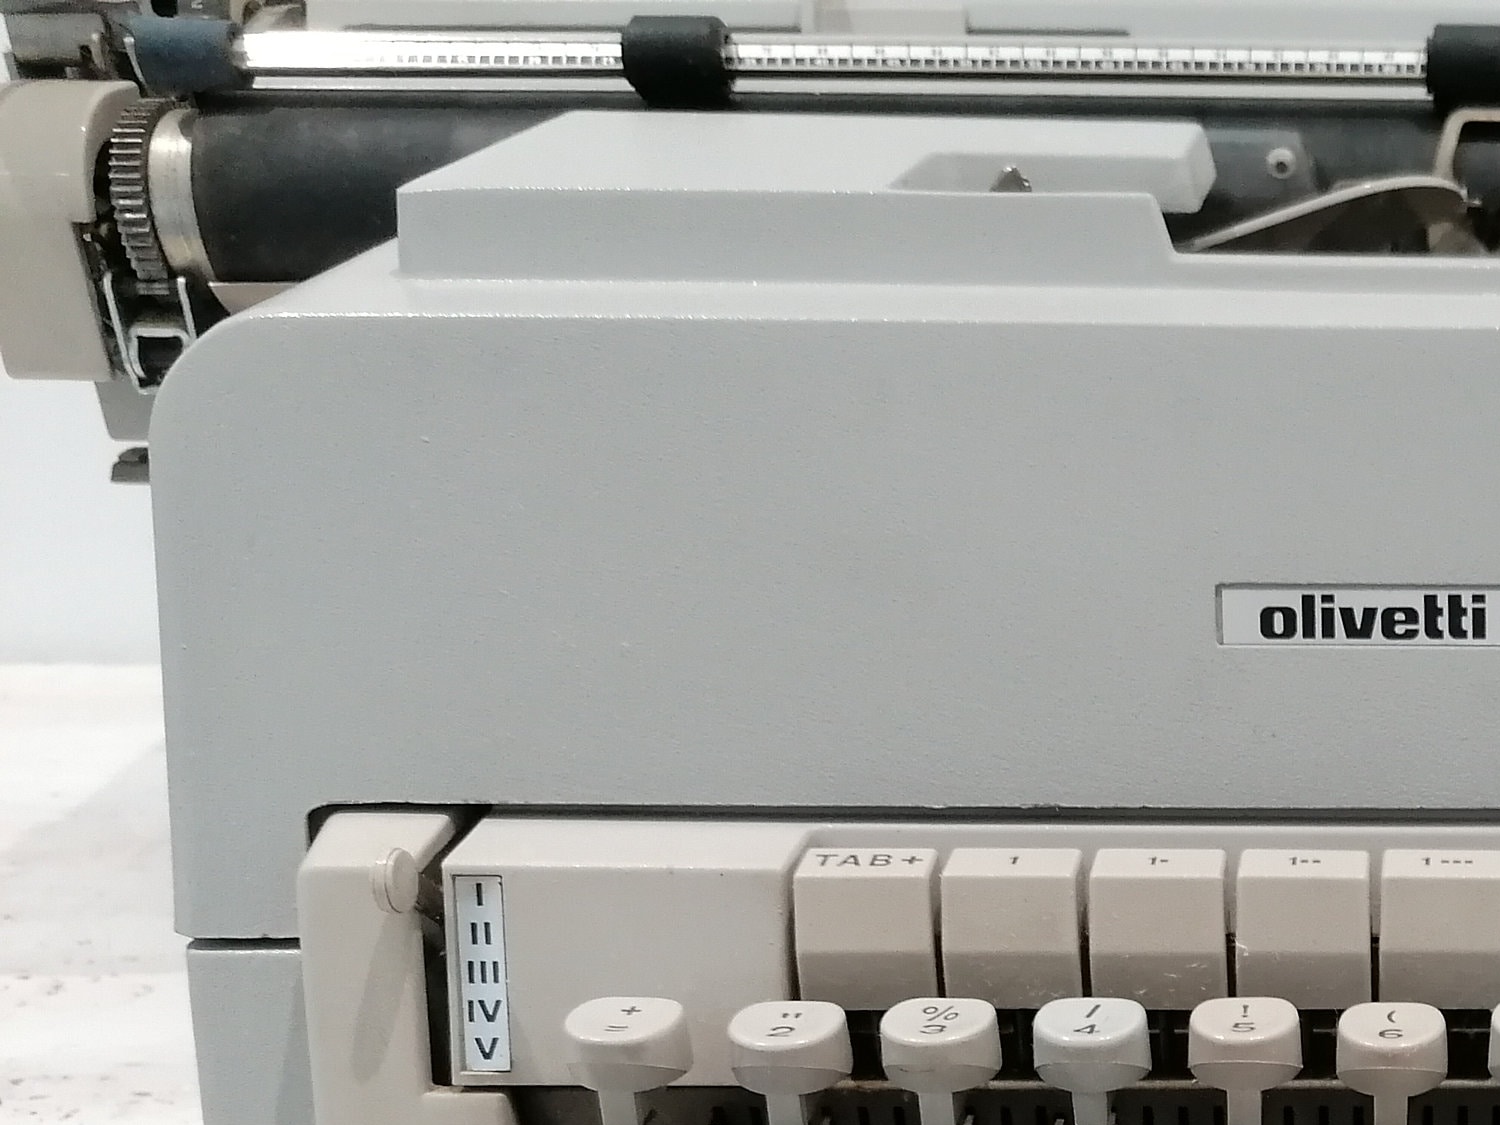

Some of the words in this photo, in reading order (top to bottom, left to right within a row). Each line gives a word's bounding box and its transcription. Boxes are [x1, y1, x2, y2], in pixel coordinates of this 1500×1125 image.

[1259, 593, 1487, 641] olivetti
[467, 999, 502, 1023] IV
[922, 1005, 960, 1022] %
[766, 1026, 796, 1037] 2
[1072, 1023, 1100, 1035] 4
[1231, 1022, 1256, 1033] 5
[1378, 1028, 1404, 1039] 6
[474, 1037, 499, 1061] V
